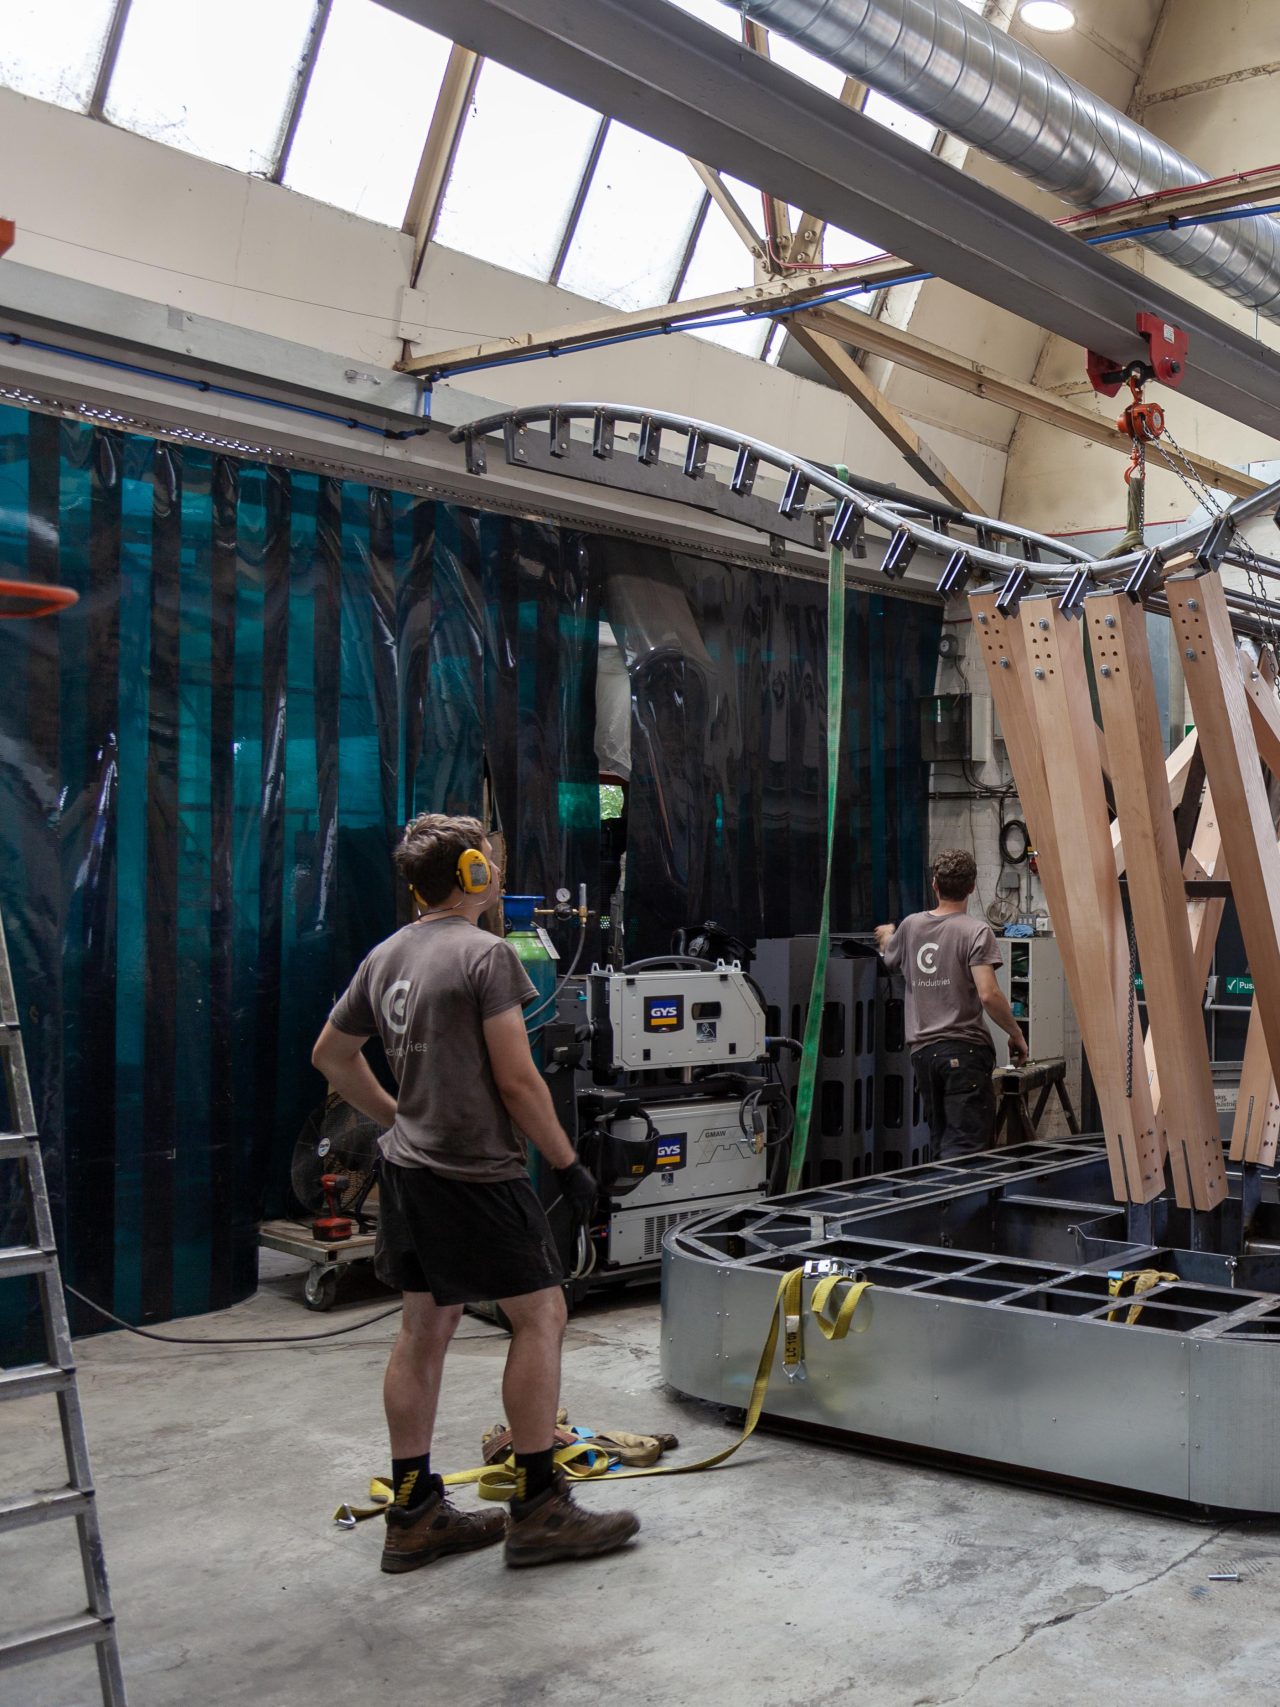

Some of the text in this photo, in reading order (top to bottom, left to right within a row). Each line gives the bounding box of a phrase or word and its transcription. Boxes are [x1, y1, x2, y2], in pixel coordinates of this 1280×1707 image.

[650, 1006, 678, 1017] GYS
[705, 1130, 726, 1139] GMAW
[657, 1144, 681, 1156] GYS
